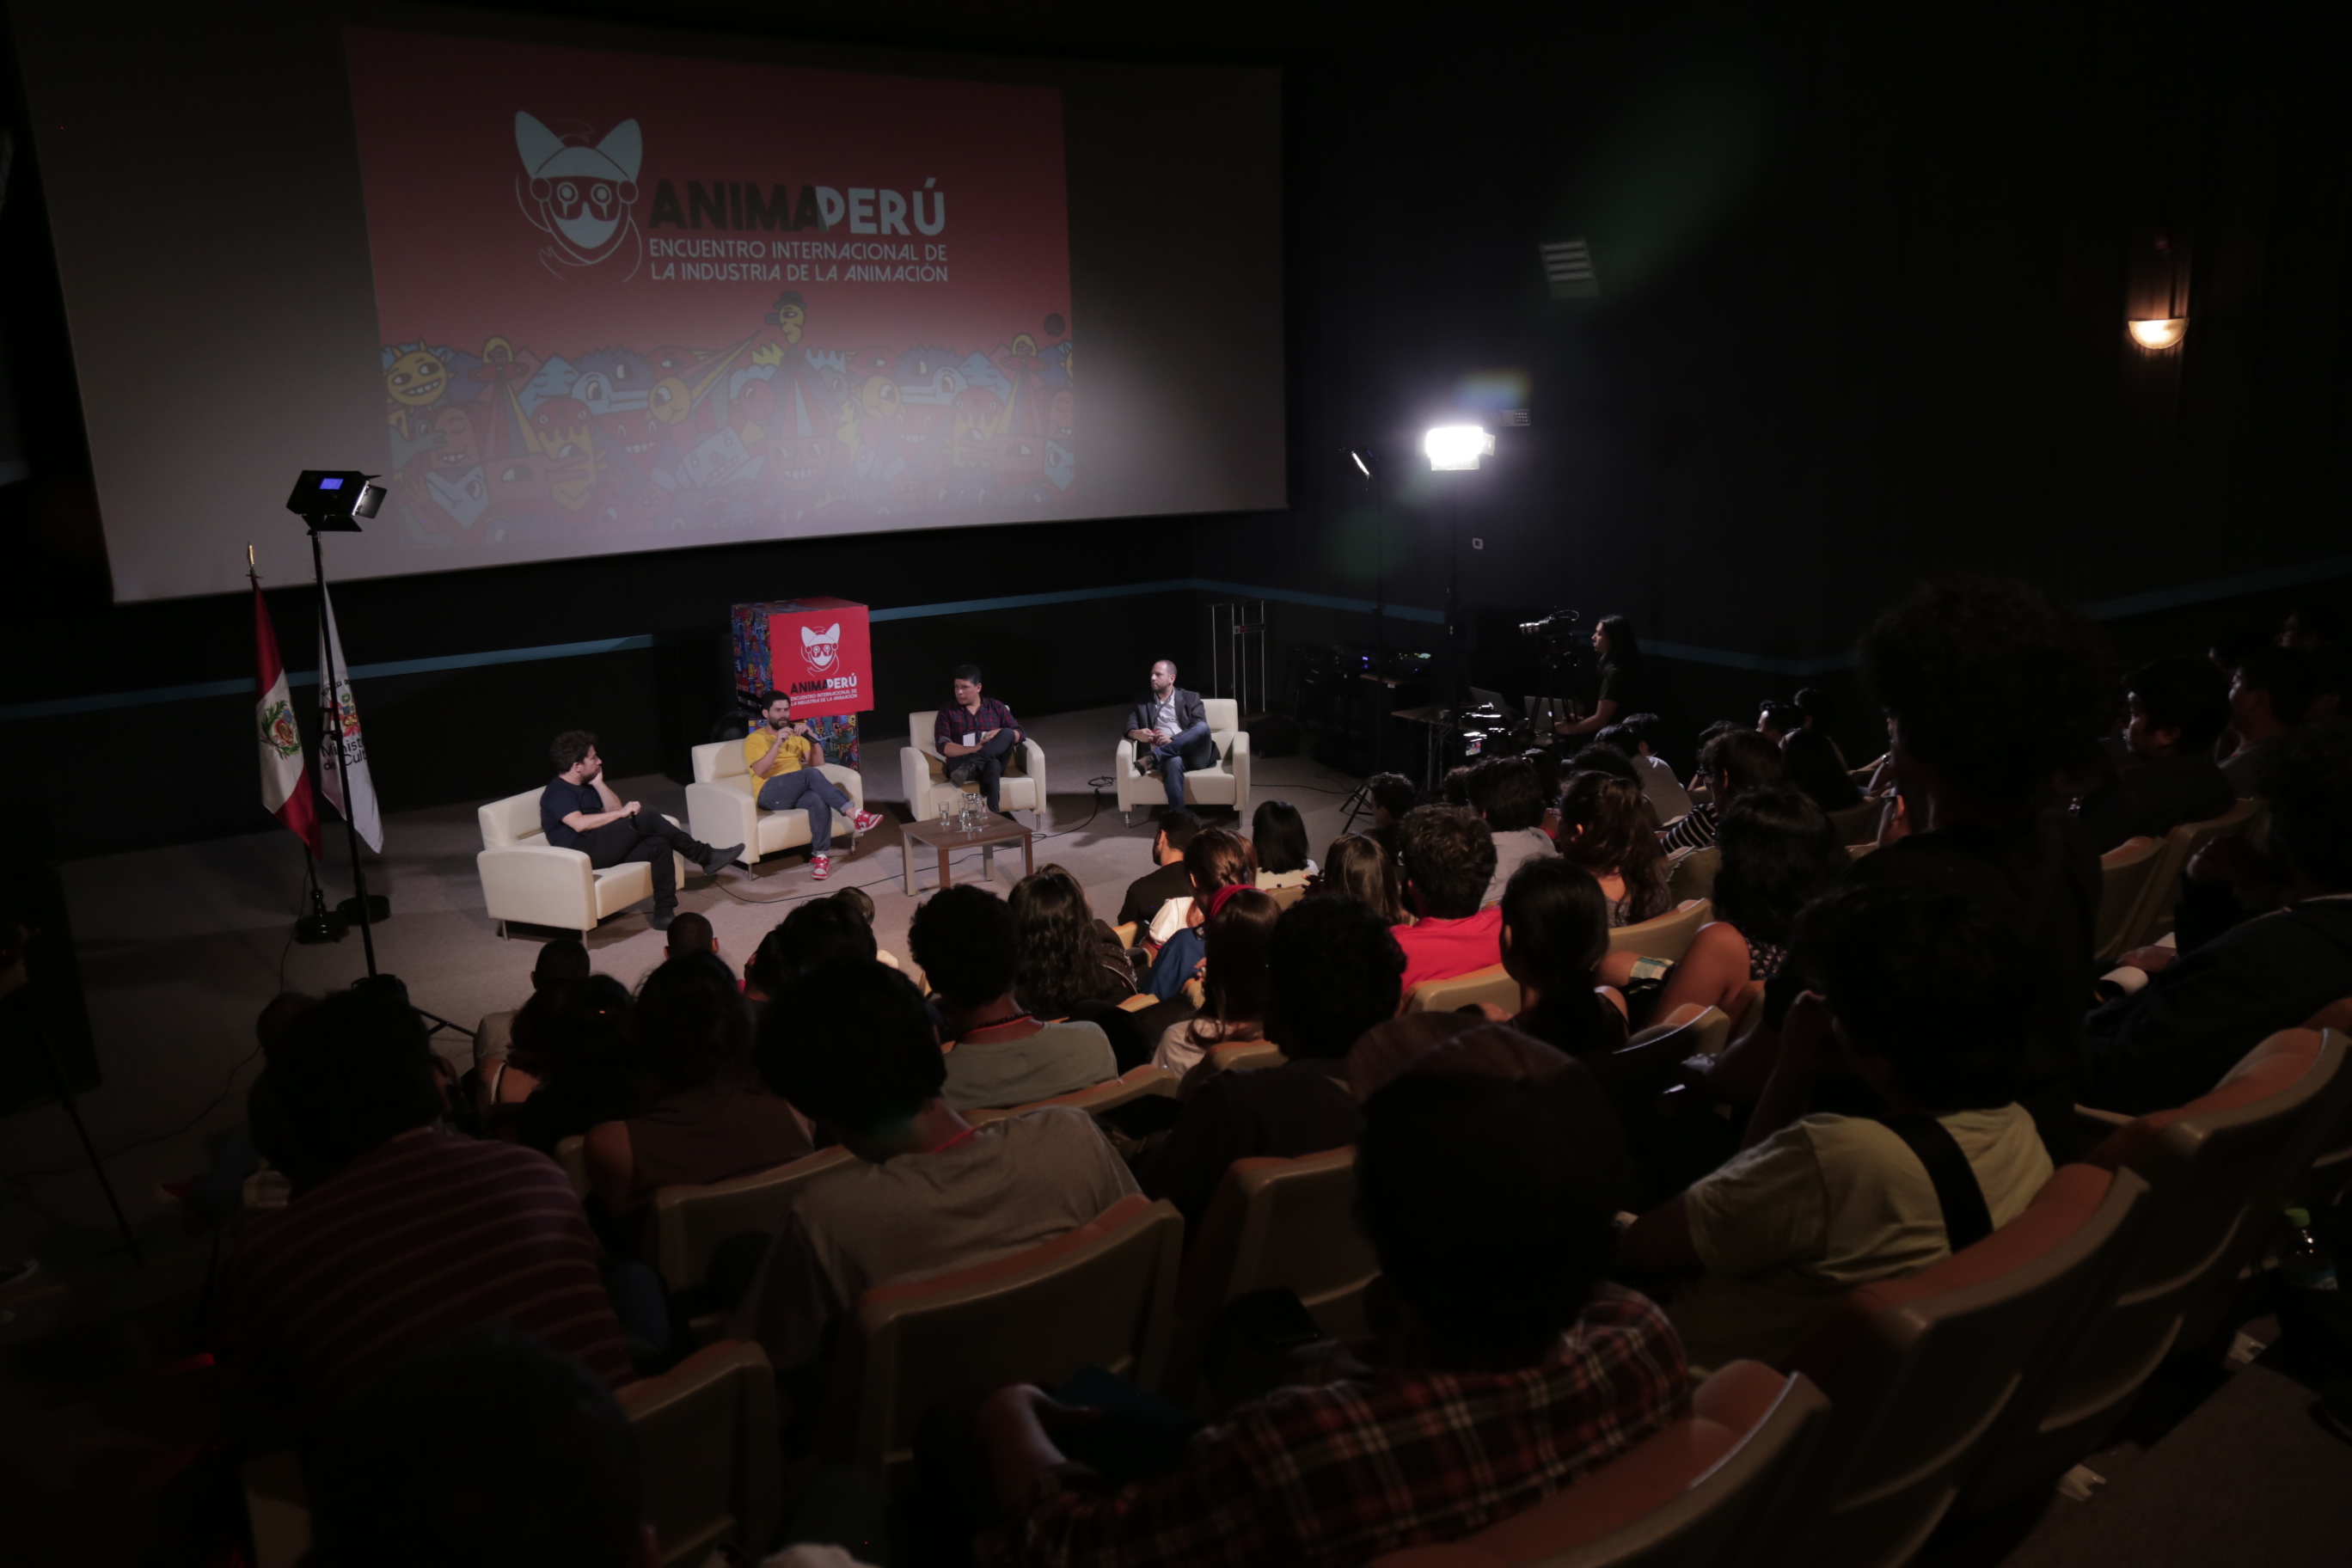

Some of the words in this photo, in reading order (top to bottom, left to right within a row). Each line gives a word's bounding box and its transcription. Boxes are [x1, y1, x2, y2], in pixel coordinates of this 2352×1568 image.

[649, 238, 766, 258] ENCUENTRO
[772, 241, 920, 260] INTERNACIONAL
[925, 243, 947, 261] DE
[651, 262, 676, 280] LA
[682, 262, 781, 281] INDUSTRIA
[787, 264, 810, 281] DE
[816, 264, 838, 282] LA
[843, 263, 948, 282] ANIMACIÓN
